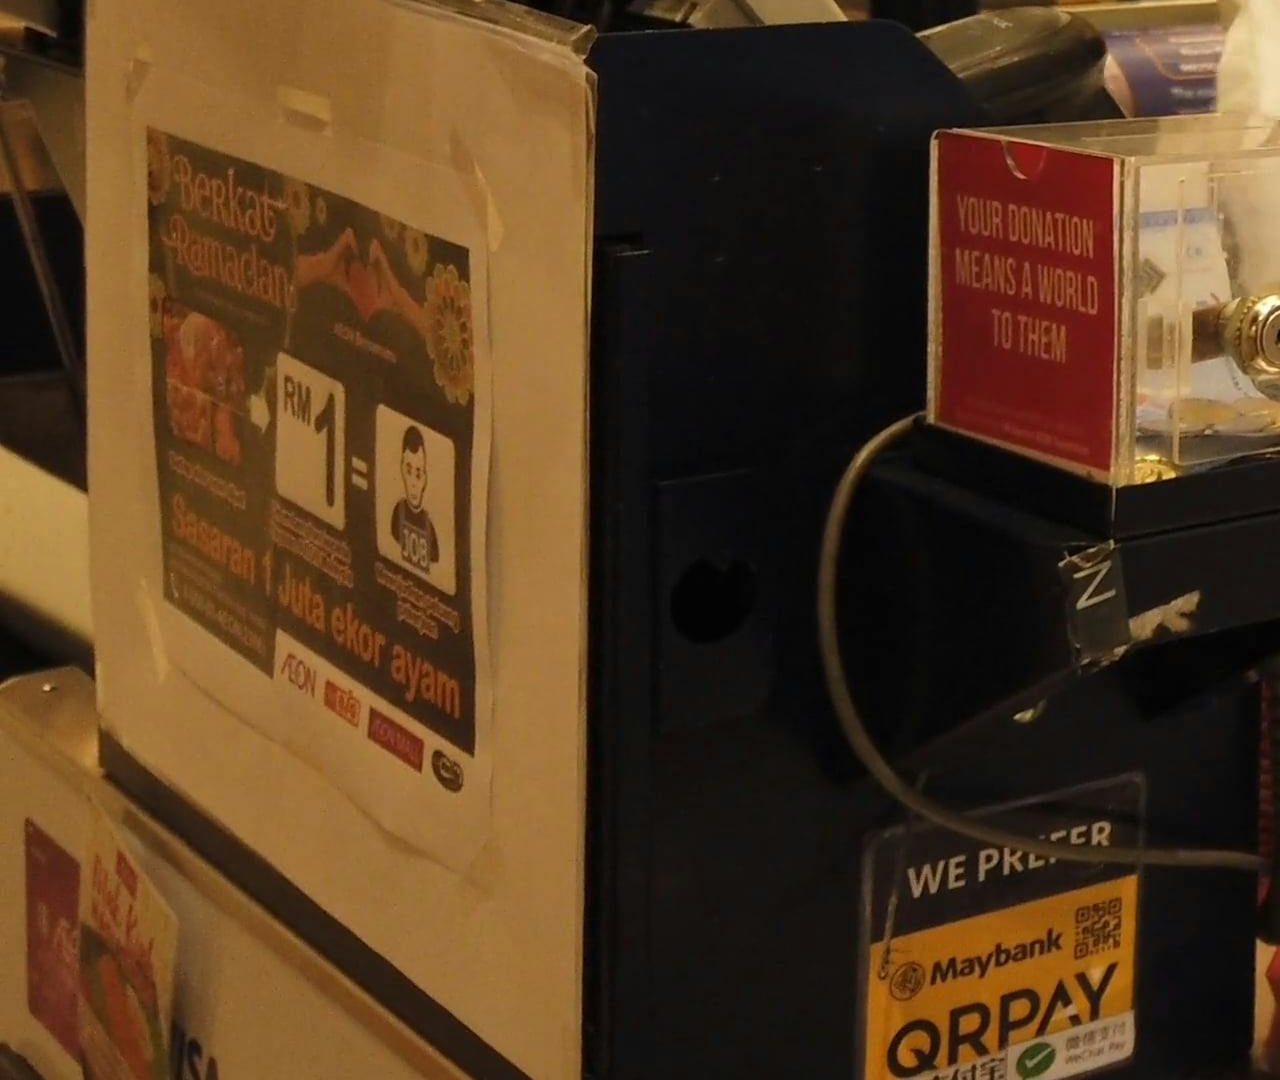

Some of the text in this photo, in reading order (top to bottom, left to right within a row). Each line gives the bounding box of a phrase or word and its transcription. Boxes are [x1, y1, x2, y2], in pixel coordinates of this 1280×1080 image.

[172, 153, 288, 243] Berkat
[956, 194, 1095, 260] YOUR DONATION
[161, 215, 295, 313] Ramadan
[955, 248, 1099, 316] MEANS A WORLD
[991, 309, 1068, 364] TO THEM
[283, 375, 336, 508] RM 1
[171, 495, 256, 584] Sasaran
[262, 551, 273, 596] 1
[278, 561, 326, 630] Juta
[331, 602, 386, 668] ekor
[390, 643, 460, 719] ayam
[907, 820, 1113, 899] WE PRER
[930, 927, 1063, 986] Maybank
[886, 961, 1118, 1079] QRPAY
